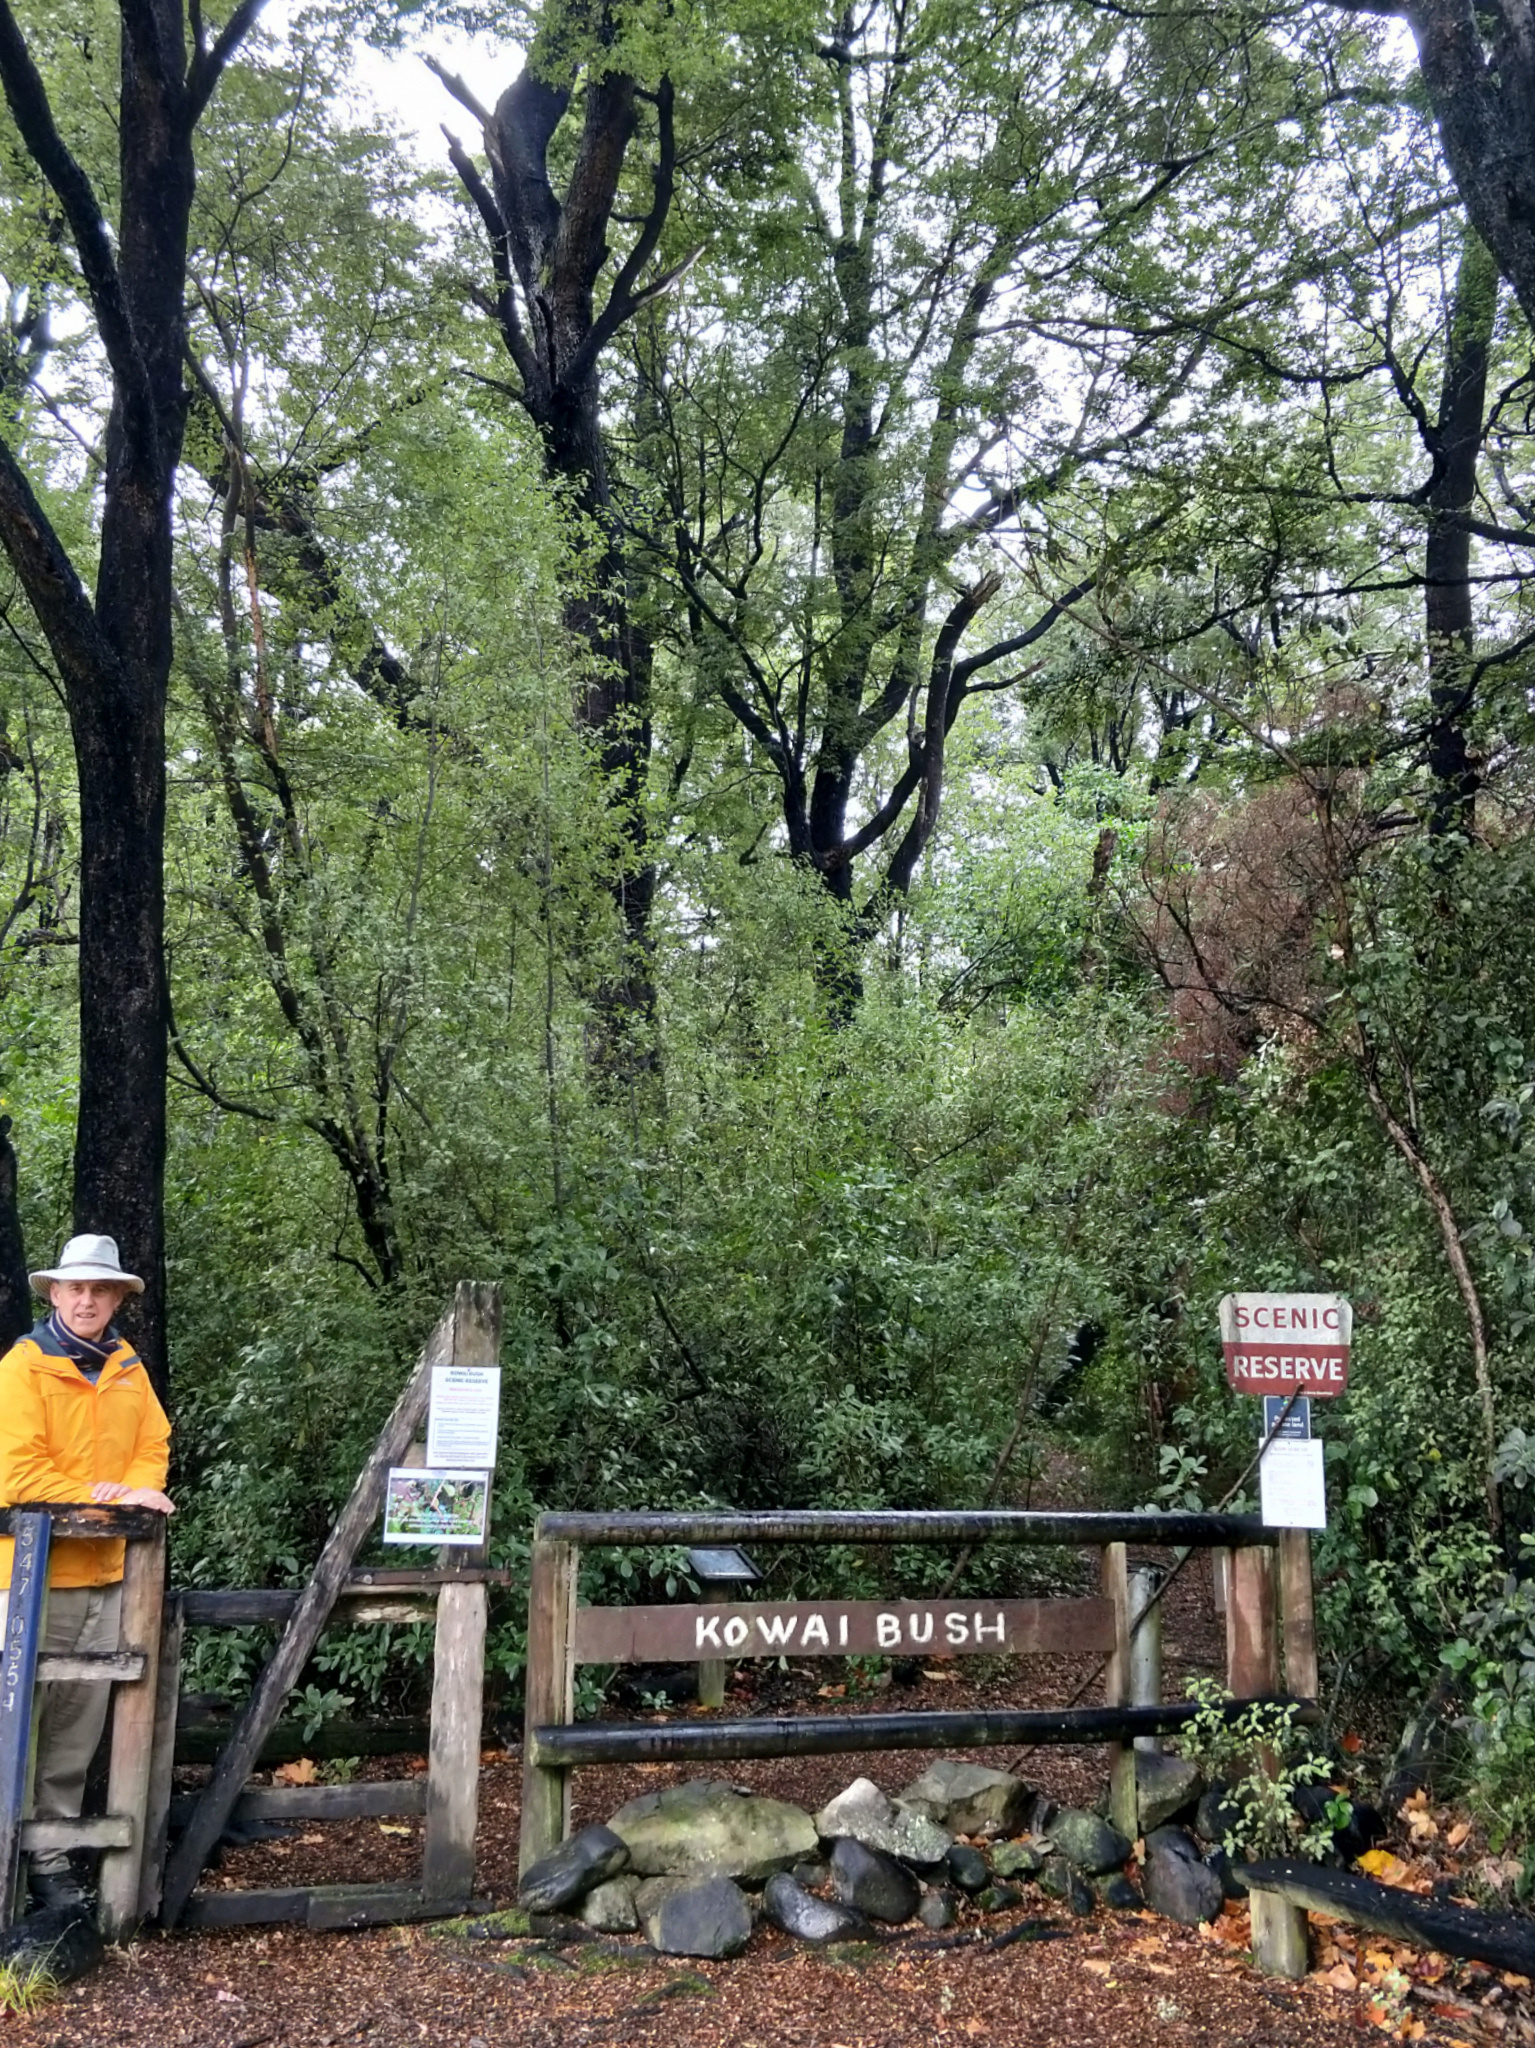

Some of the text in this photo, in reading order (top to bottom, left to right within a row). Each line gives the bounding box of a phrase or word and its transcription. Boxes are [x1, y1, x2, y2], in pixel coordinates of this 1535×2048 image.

[1234, 1307, 1339, 1330] SCENIC
[1233, 1356, 1343, 1381] RESERVE
[694, 1611, 1006, 1649] KOWAI BUSH
